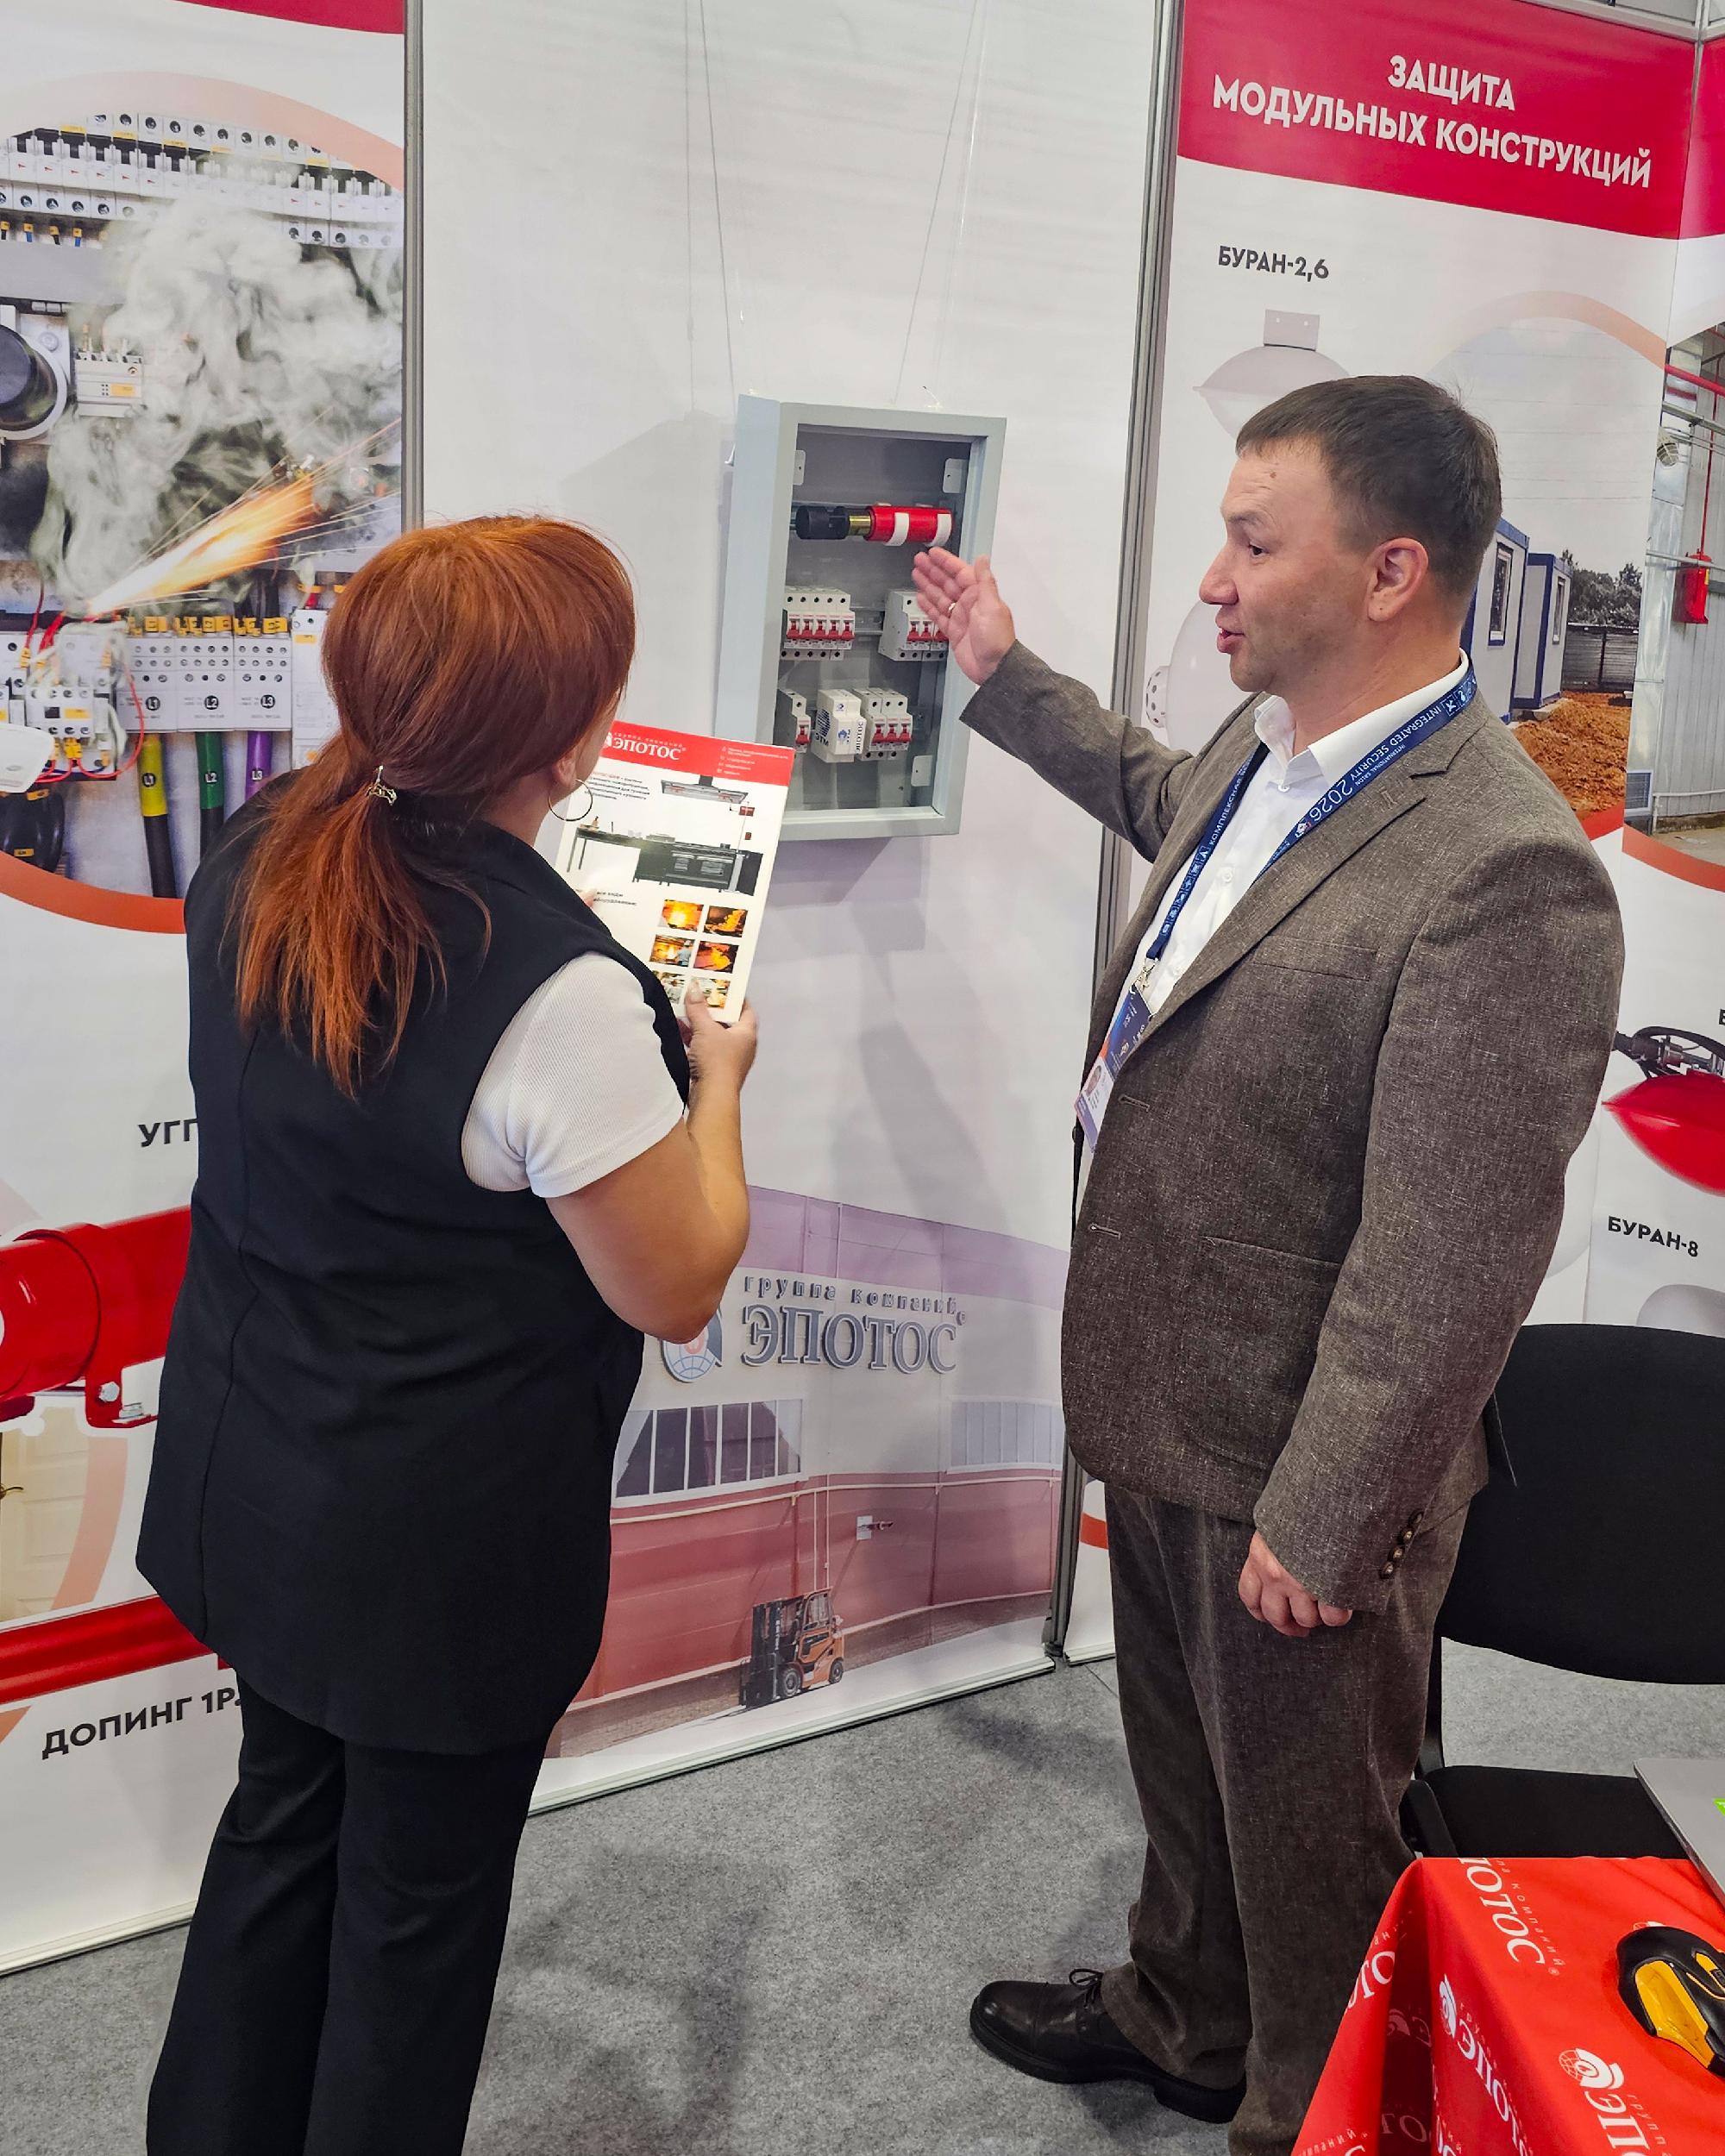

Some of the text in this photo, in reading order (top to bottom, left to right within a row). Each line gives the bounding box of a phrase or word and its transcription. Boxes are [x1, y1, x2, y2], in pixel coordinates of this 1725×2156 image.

[1387, 55, 1515, 110] ЗАЩИТА
[1213, 74, 1651, 188] МОДУЛЬНЫХ КОНСТРУКЦИЙ
[1218, 245, 1329, 282] БУРАН-2,6
[205, 697, 218, 709] L2
[261, 695, 274, 707] L3
[612, 737, 681, 761] ЭПОТОС
[1351, 707, 1442, 781] INTEGRATED SECURITY
[205, 773, 217, 783] L2
[1309, 779, 1353, 821] 2026
[1608, 1215, 1698, 1257] БУРАН-8
[745, 1275, 959, 1314] группа компаний
[741, 1303, 957, 1374] ЭПОТОС
[42, 1687, 242, 1760] ДОПИНГ 1Р
[1584, 2090, 1650, 2156] ЭП
